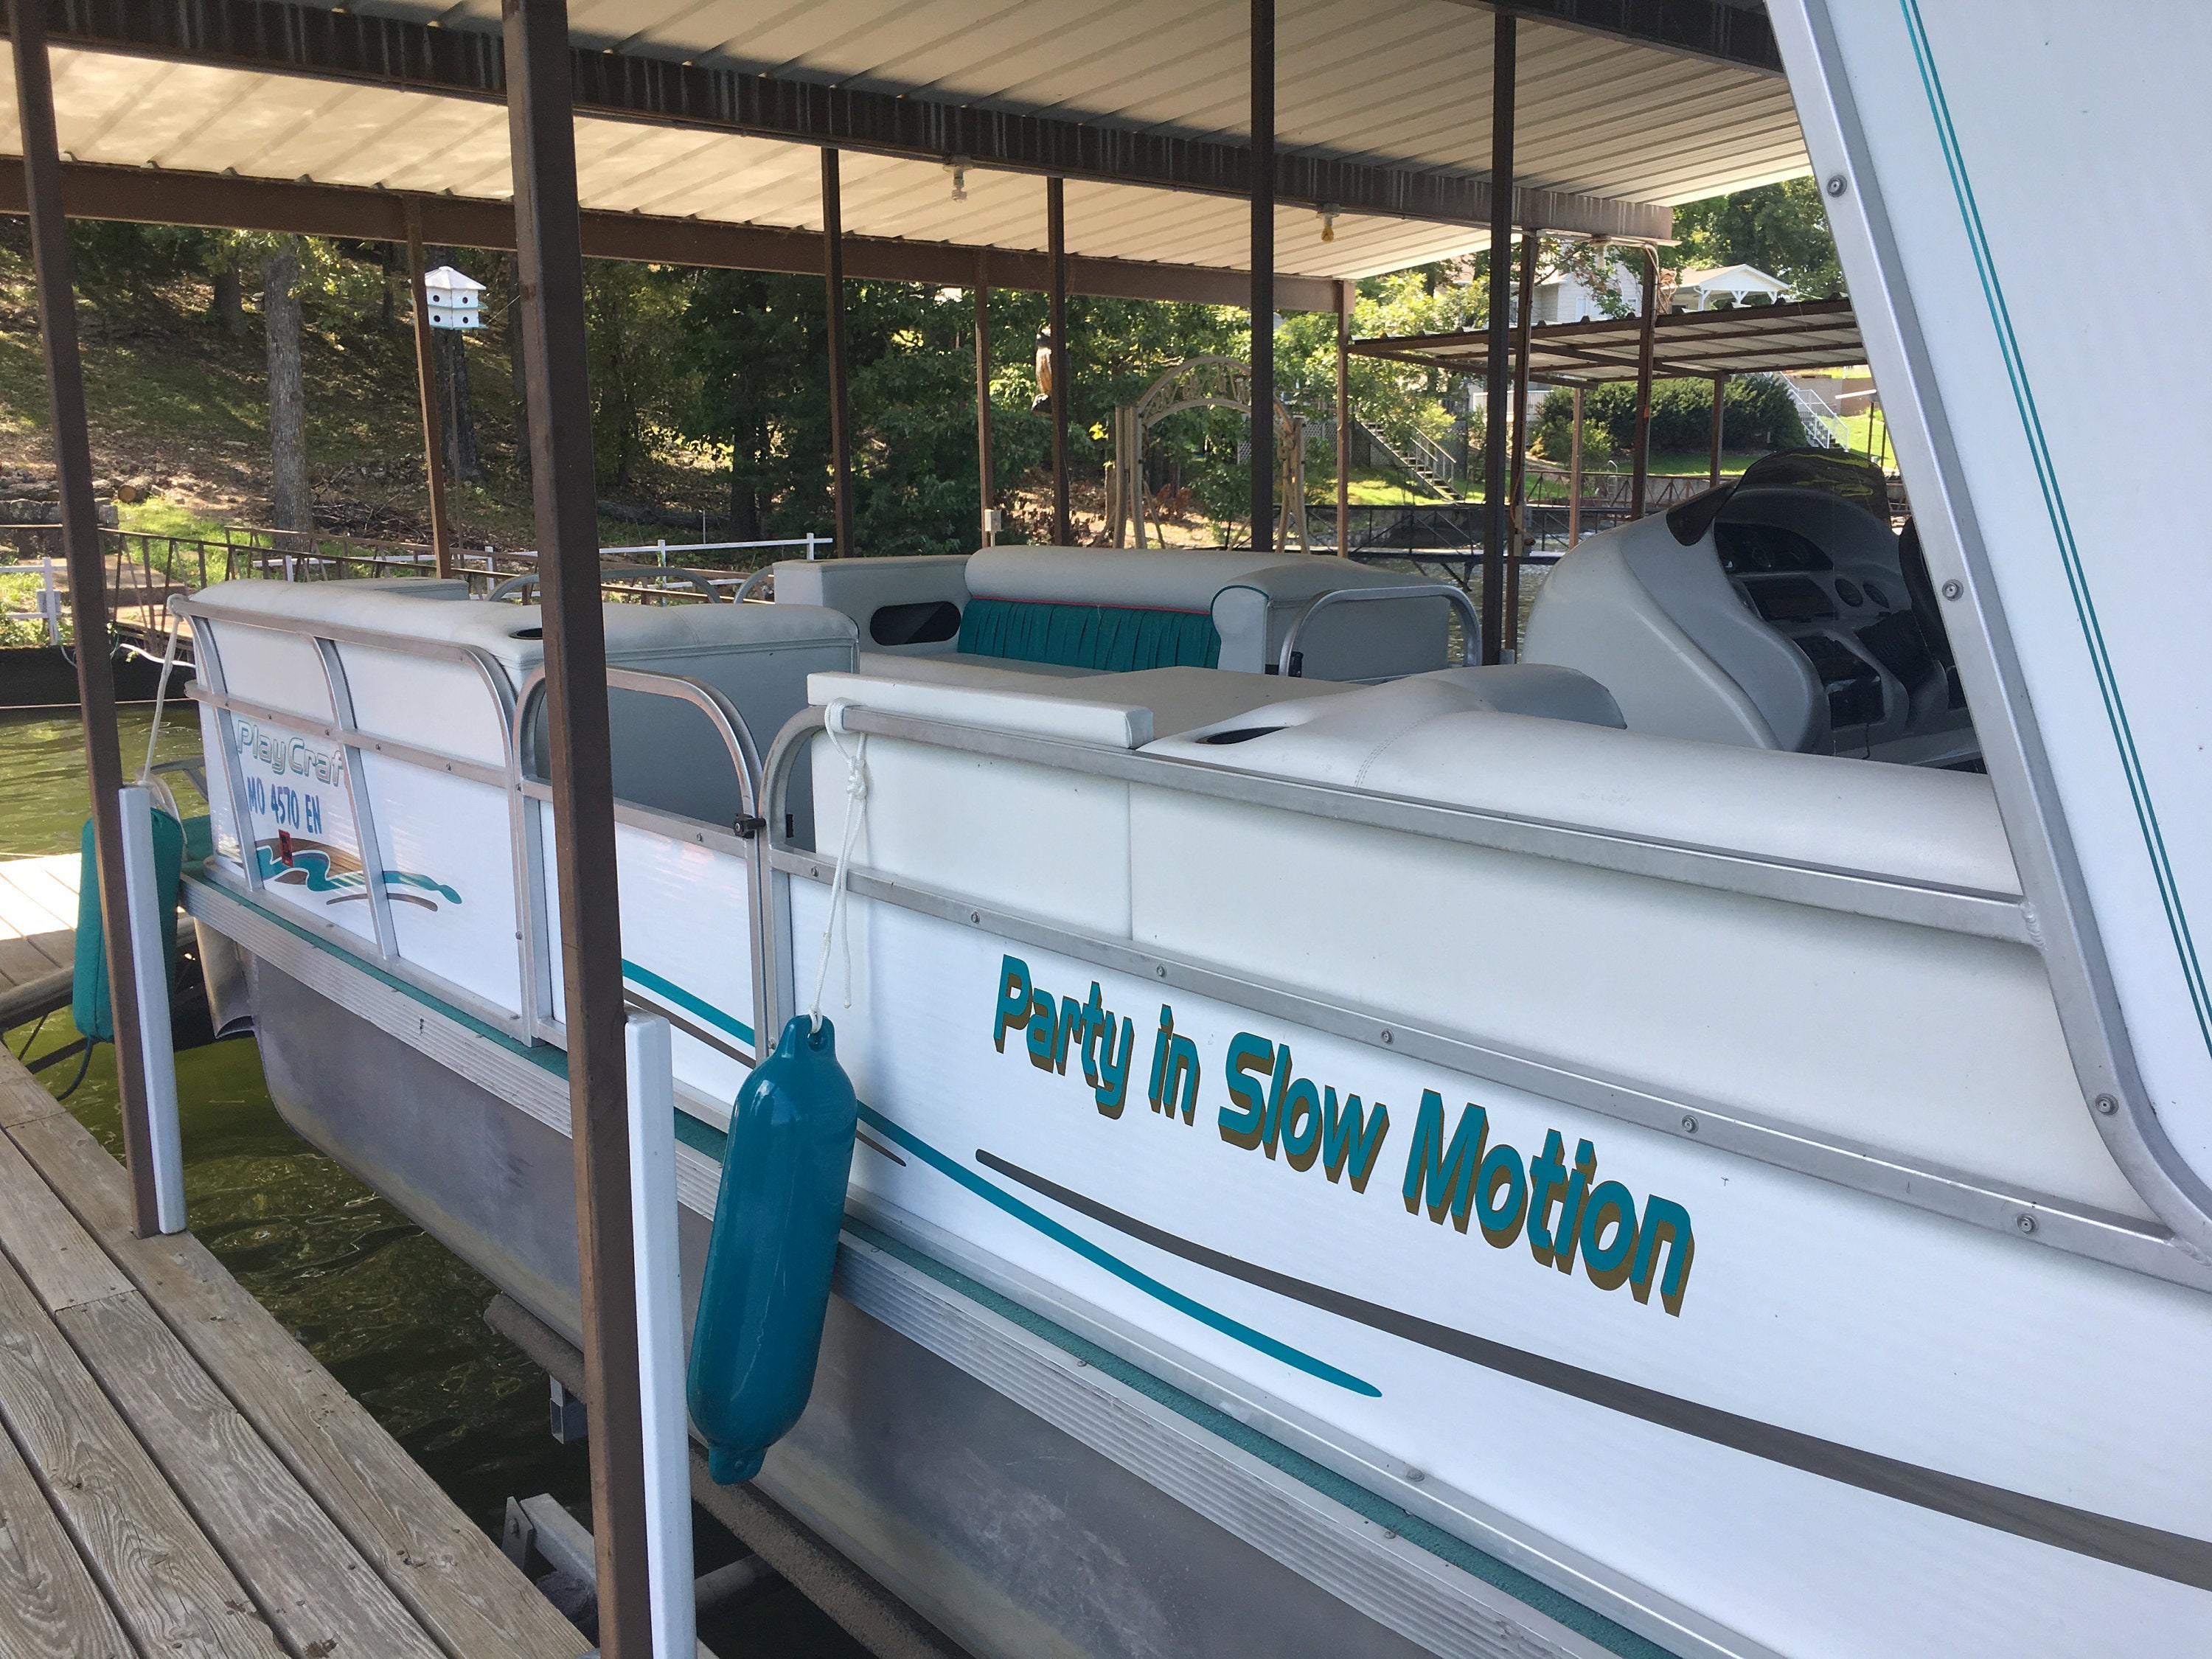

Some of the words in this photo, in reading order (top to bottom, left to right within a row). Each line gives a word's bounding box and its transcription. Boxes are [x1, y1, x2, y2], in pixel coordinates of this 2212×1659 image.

[237, 720, 343, 787] PlayCraf
[247, 776, 265, 815] MO
[271, 783, 300, 830] 4570
[305, 793, 322, 835] EN
[993, 954, 1133, 1119] Party
[1148, 1004, 1200, 1126] in
[1217, 1031, 1389, 1194] Slow
[1402, 1088, 1695, 1318] Motion
